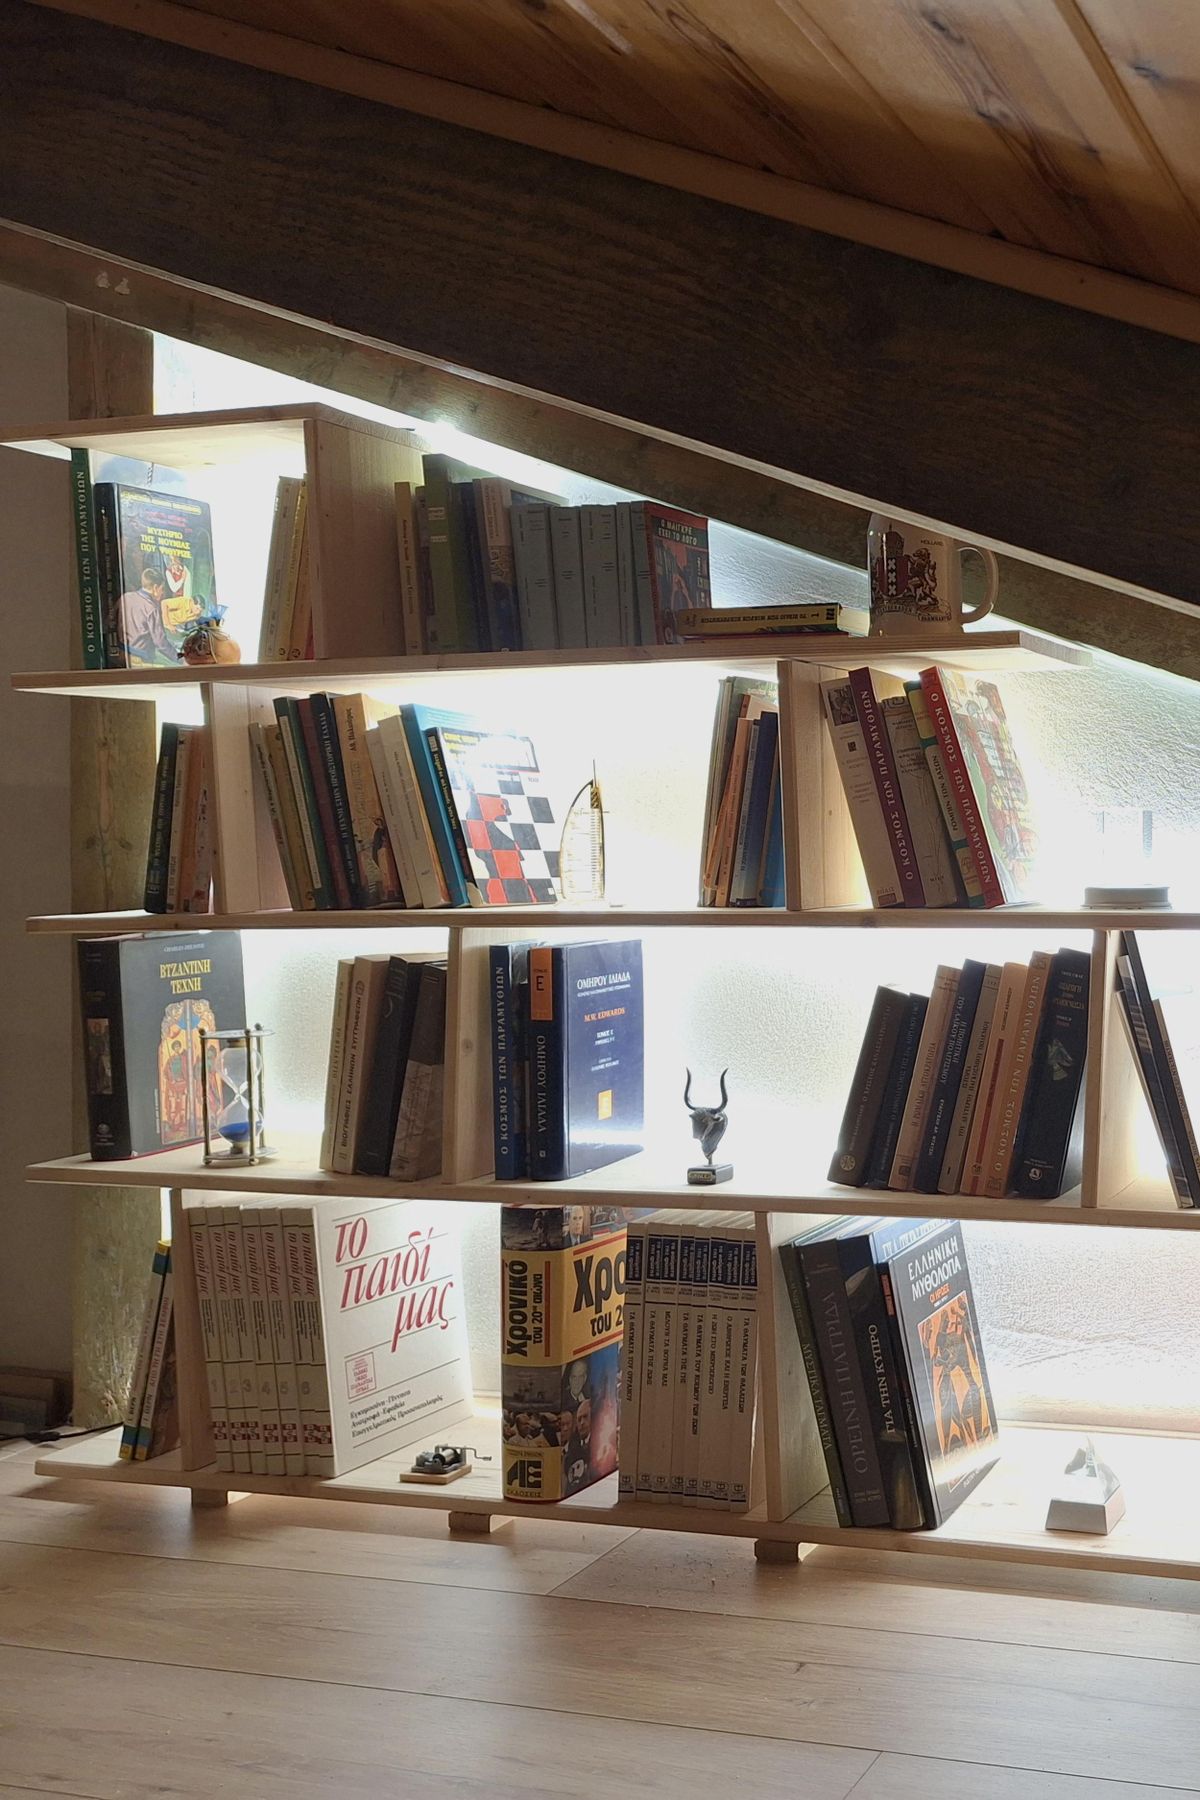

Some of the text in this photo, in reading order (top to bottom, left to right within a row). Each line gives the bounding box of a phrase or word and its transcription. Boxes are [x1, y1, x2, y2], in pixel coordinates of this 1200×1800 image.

[75, 470, 89, 552] ΠΑΡΑΜΥΘΙΩΝ
[672, 532, 681, 540] ΤΟ
[140, 534, 155, 543] ΤΗΣ
[81, 557, 90, 580] ΤΩΝ
[83, 586, 94, 638] ΚΟΣΜΟΣ
[859, 689, 914, 880] Ο ΚΟΣΜΟΣ ΤΩΝ ΠΑΡΑΜΥΘΙΩΝ
[929, 691, 993, 884] Ο ΚΟΣΜΟΣ ΤΩΝ ΠΑΡΑΜΥΘΙΩΝ
[930, 754, 944, 781] ΔΑΣΩΝ
[938, 780, 949, 799] ΤΩΝ
[170, 977, 201, 994] ΤΕΧΝΗ
[577, 974, 608, 990] ΟΜΗΡΟΥ
[608, 971, 631, 985] ΙΛΙΑΔΑ
[341, 996, 362, 1147] ΒΙΟΓΡΑΦΙΕΣ ΕΛΛΗΝΩΝ ΣΥΓΓΡΑΦΕΩΝ
[495, 966, 508, 1154] Ο ΚΟΣΜΟΣ ΤΩΝ ΠΑΡΑΜΥΘΙΩΝ
[535, 1034, 547, 1132] ΟΜΗΡΟΥ ΙΛΙΑΔΑ
[991, 974, 1042, 1171] Ο ΚΟΣΜΟΣ ΤΩΝ ΠΑΡΑΜΥΘΙΩΝ
[334, 1217, 368, 1264] το
[907, 1235, 959, 1281] ΕΛΛΗΝΙΚΗ
[340, 1226, 434, 1309] παιδί
[531, 1273, 544, 1304] αιώνα
[911, 1255, 962, 1302] ΜΥΘΟΛΟΓΙΑ
[390, 1280, 454, 1353] μας
[505, 1259, 528, 1358] Χρονικό
[532, 1326, 544, 1345] του
[799, 1341, 821, 1396] ΜΥΣΤΙΚΑ
[821, 1289, 870, 1474] ΟΡΕΙΝΗ ΠΑΤΡΙΔΑ
[867, 1323, 895, 1434] ΓΙΑ ΤΗΝ ΚΥΠΡΟ
